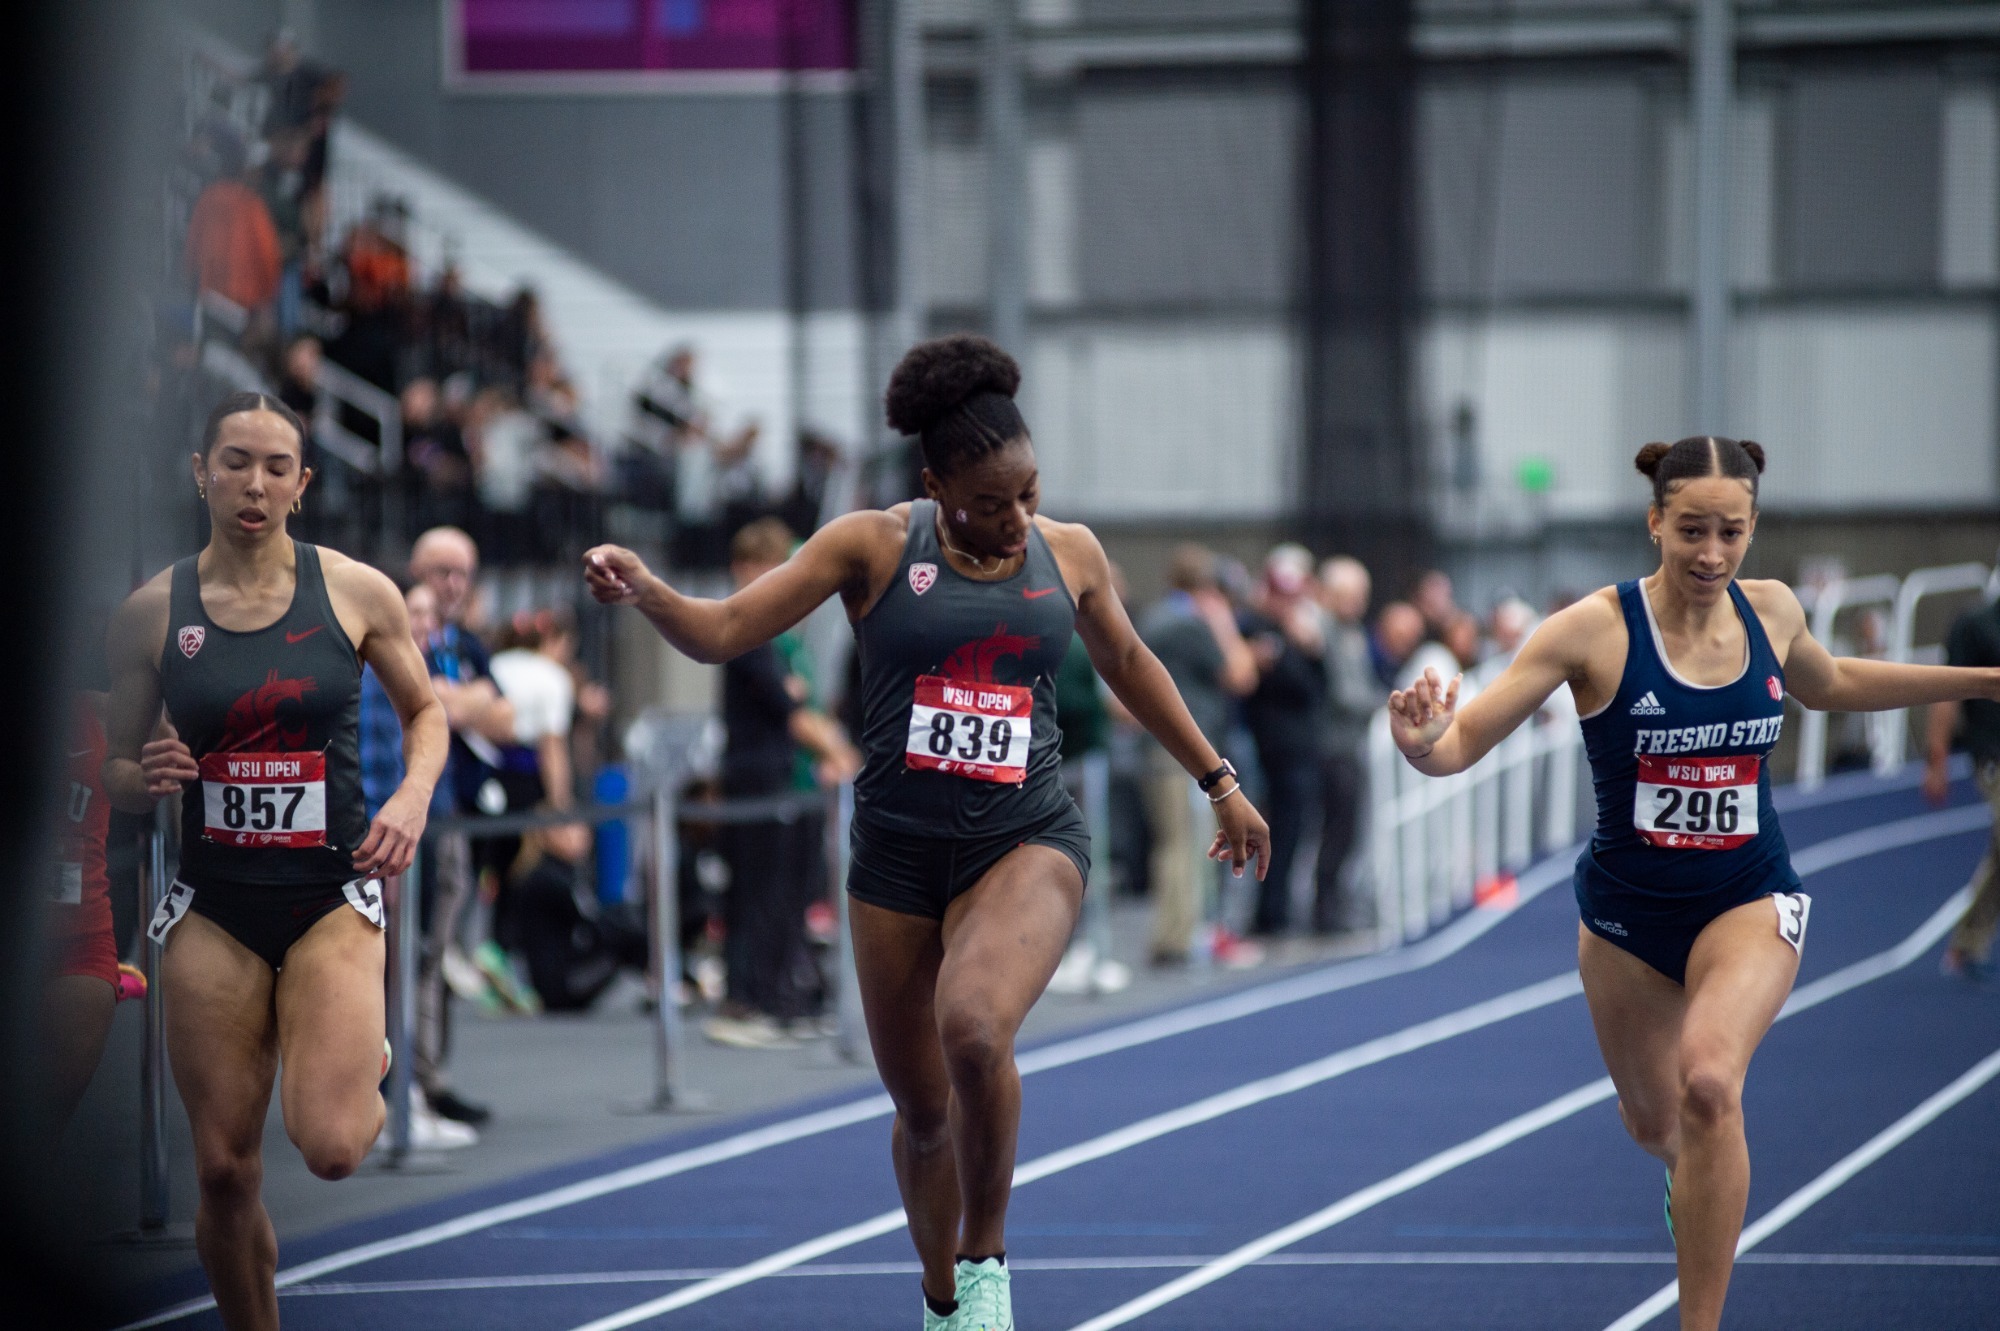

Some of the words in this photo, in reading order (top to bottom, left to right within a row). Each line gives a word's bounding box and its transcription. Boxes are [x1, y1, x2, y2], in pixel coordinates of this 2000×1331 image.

[914, 576, 928, 588] 12
[184, 639, 199, 652] 12
[942, 686, 975, 707] WSU
[977, 691, 1012, 711] OPEN
[1629, 706, 1666, 716] adidas
[928, 712, 1012, 763] 839
[1634, 723, 1728, 754] FRESNO
[1728, 715, 1784, 746] STATE
[227, 761, 260, 777] WSU
[265, 761, 300, 777] OPEN
[1668, 765, 1701, 782] WSU
[1704, 765, 1736, 782] OPEN
[222, 785, 306, 831] 857
[1653, 788, 1740, 833] 296
[1594, 918, 1629, 937] adidas
[1784, 894, 1804, 944] 3
